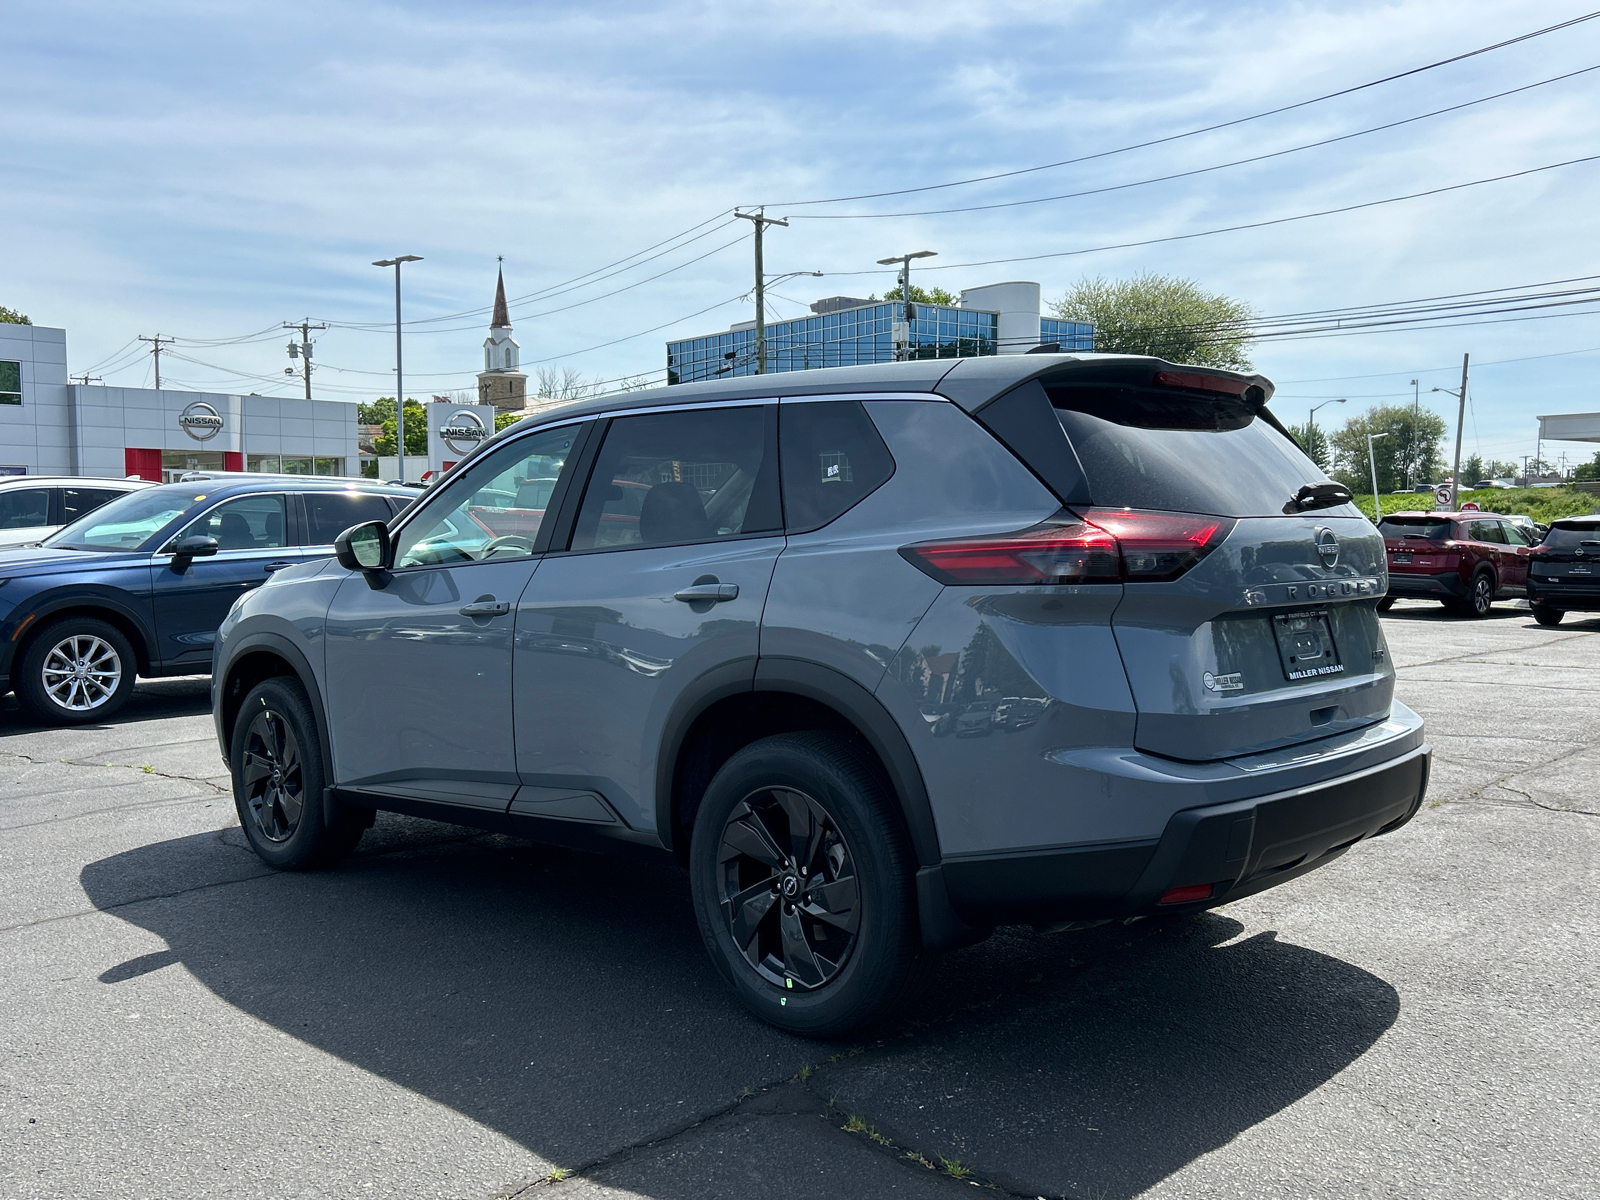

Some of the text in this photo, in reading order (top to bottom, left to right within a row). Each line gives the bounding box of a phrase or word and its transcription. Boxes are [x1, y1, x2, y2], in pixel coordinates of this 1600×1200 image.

[184, 416, 220, 425] NISSAN
[446, 428, 486, 437] NISSAN
[1319, 546, 1339, 554] NISS
[1287, 582, 1369, 599] ROGUE
[1289, 664, 1344, 680] MILLER NISSAN
